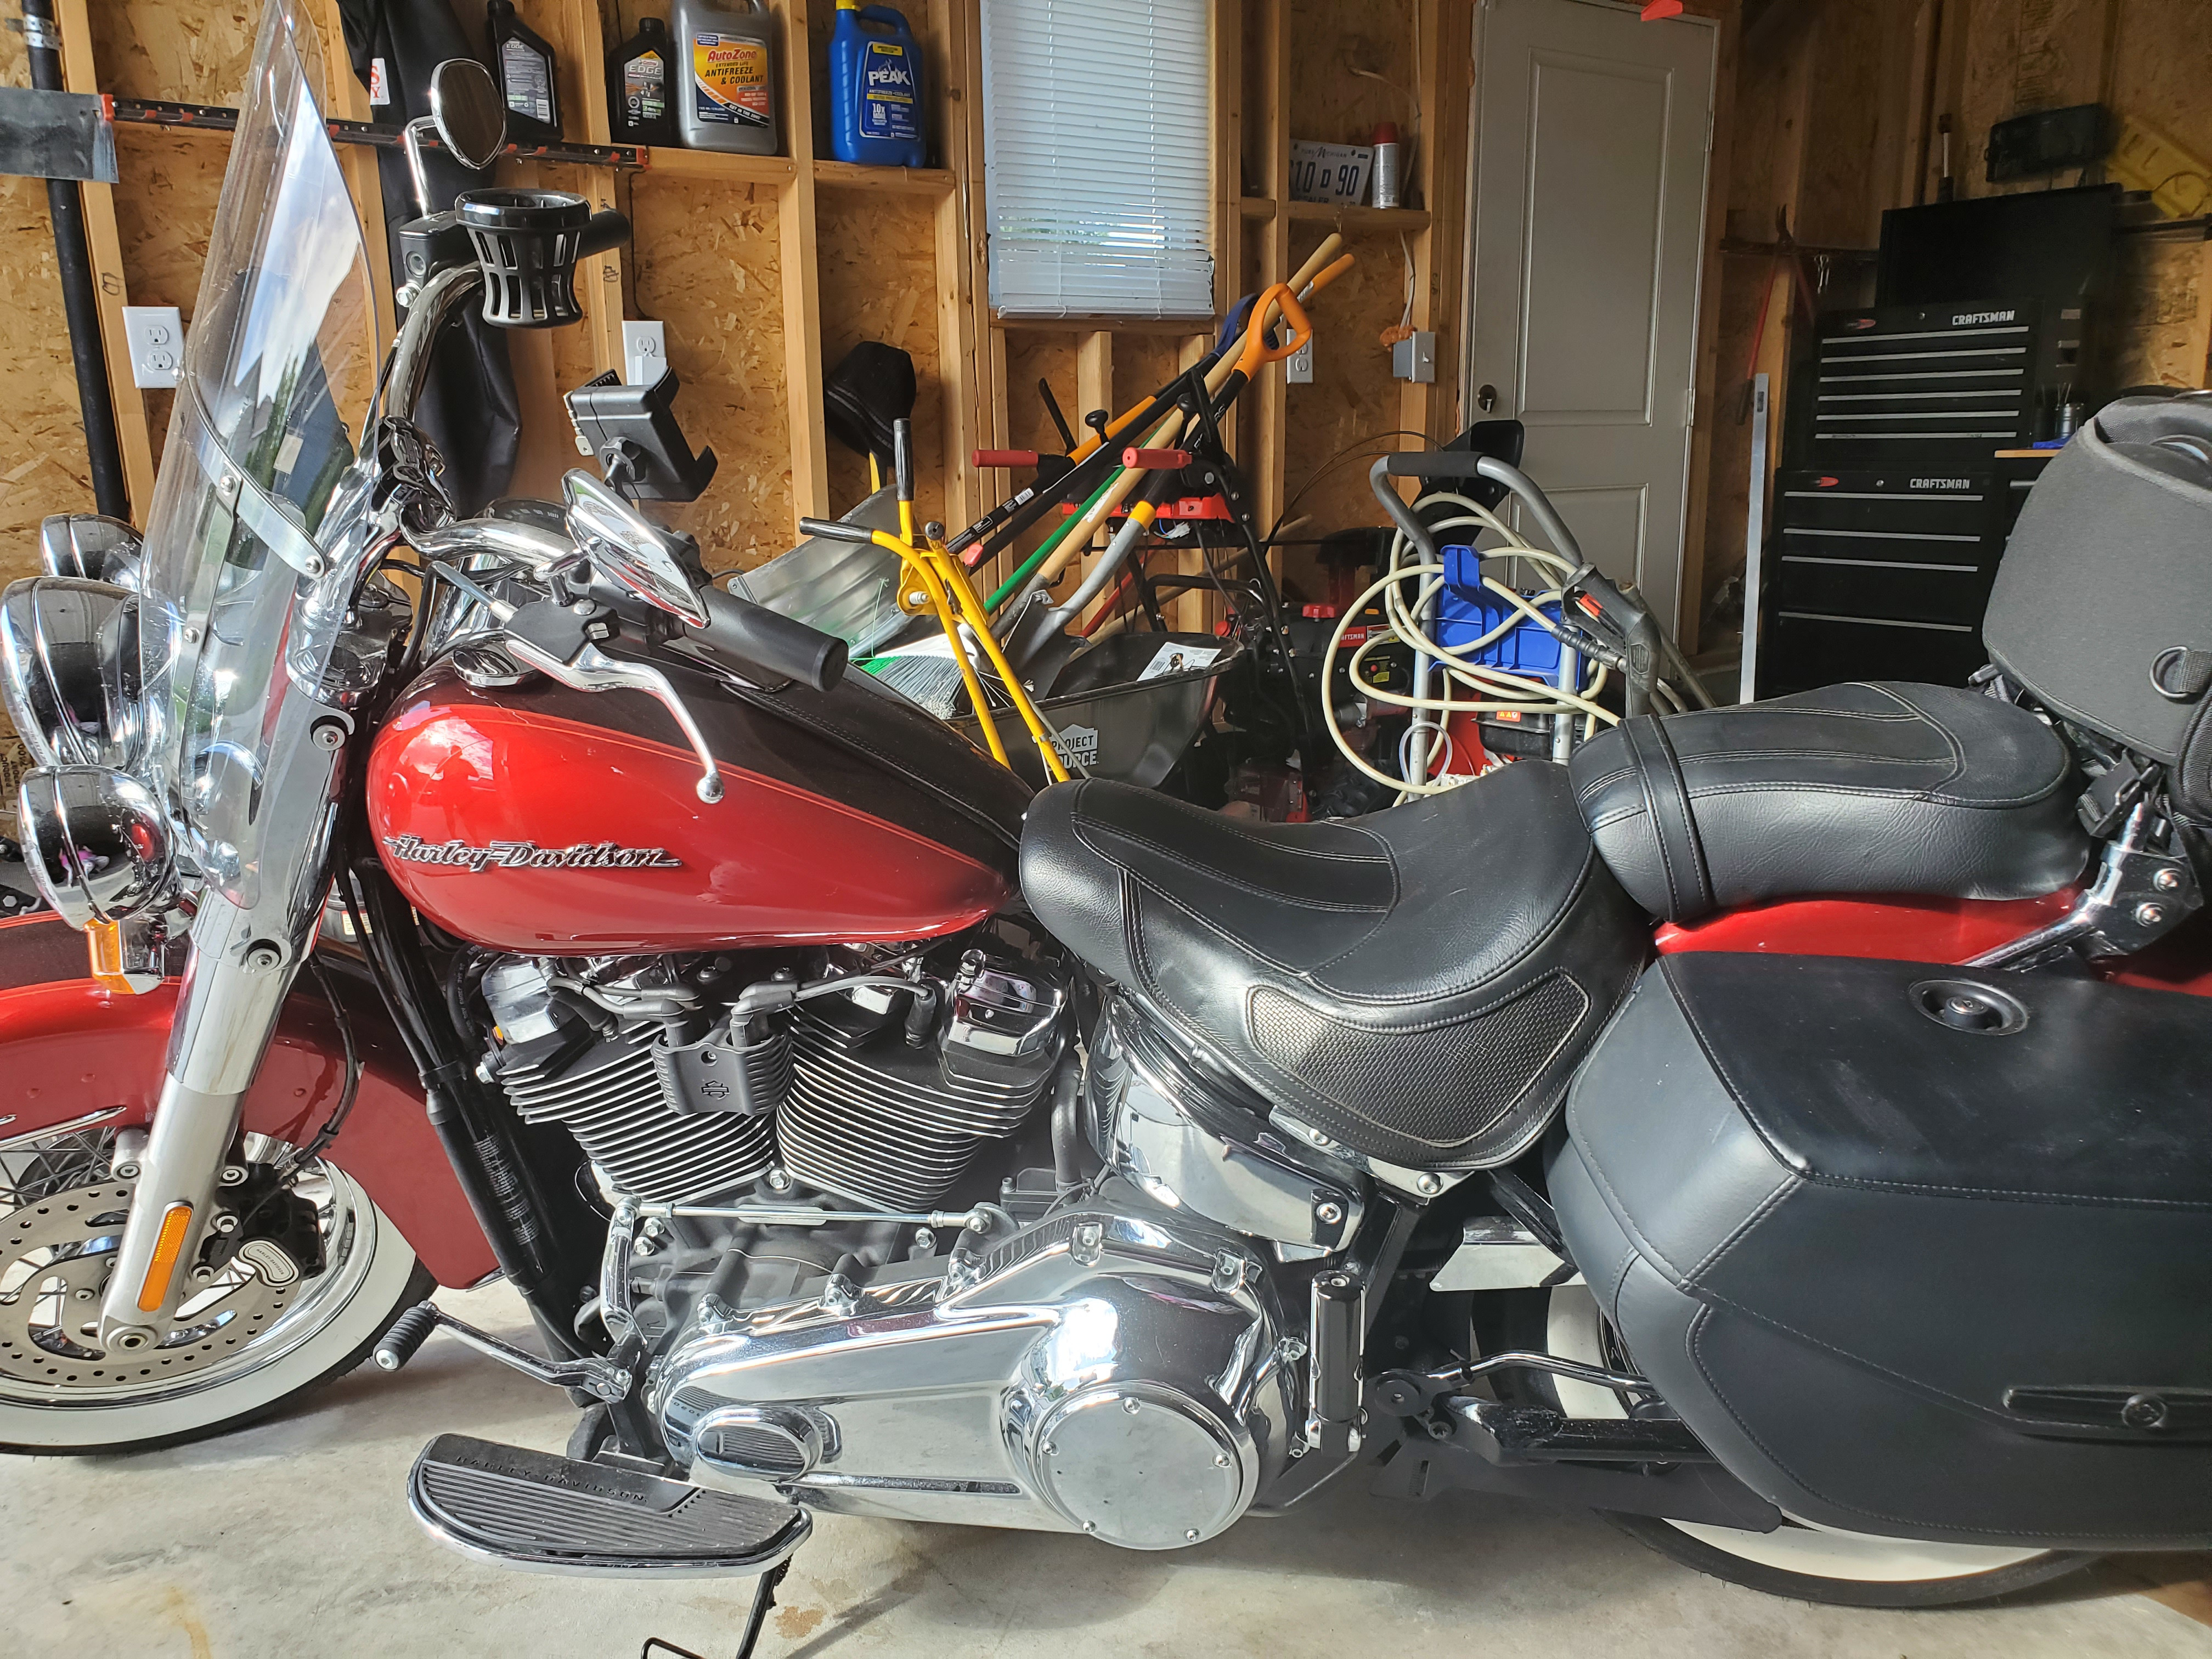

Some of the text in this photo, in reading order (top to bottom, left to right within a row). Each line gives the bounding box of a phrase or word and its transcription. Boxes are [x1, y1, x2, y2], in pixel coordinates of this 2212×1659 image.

[707, 48, 758, 63] AutoZone
[629, 65, 662, 75] EDGE
[704, 66, 754, 77] ANTIFREEZE
[730, 75, 764, 84] COOLANT
[868, 70, 911, 86] PEAK
[1951, 310, 2015, 326] CRAFTSMAN
[1909, 478, 1971, 489] CRAFTSMAN
[383, 833, 682, 872] Harley-Davidson
